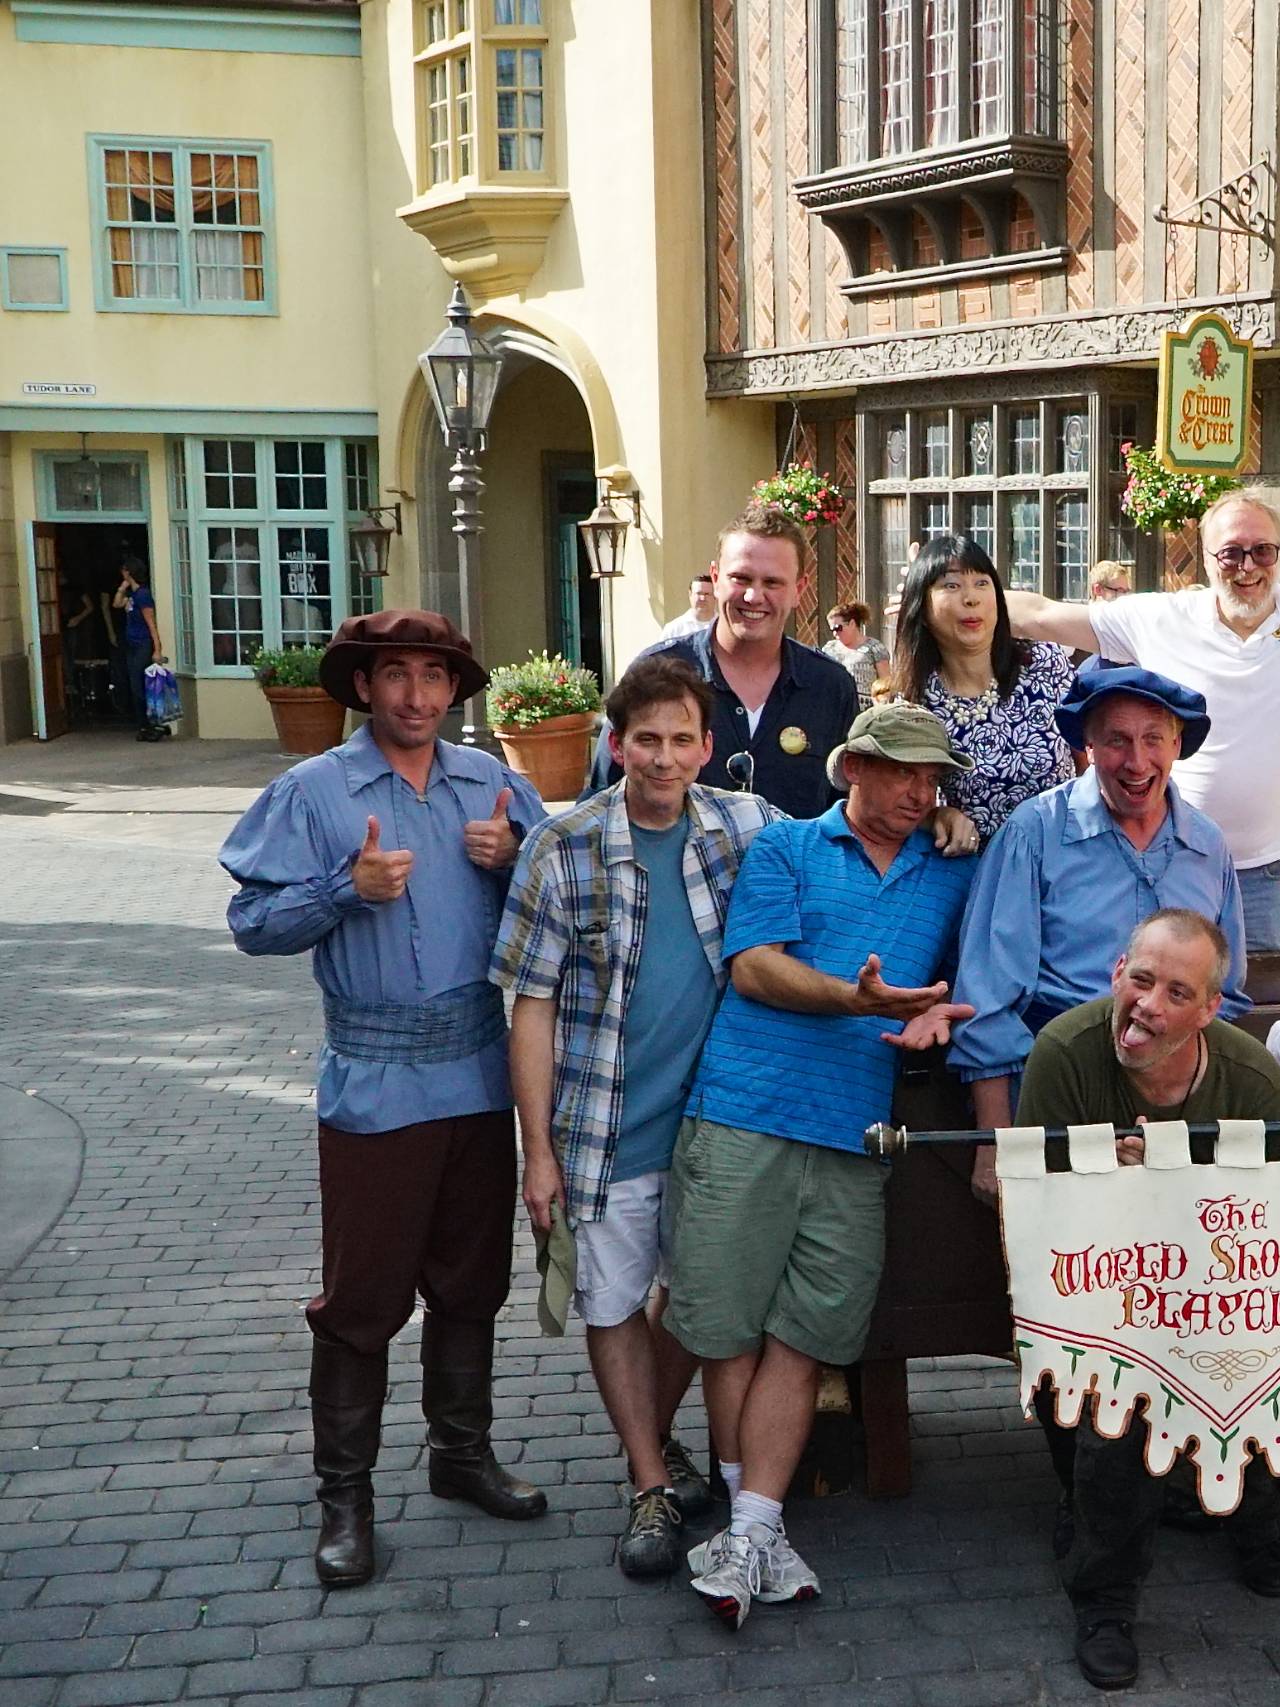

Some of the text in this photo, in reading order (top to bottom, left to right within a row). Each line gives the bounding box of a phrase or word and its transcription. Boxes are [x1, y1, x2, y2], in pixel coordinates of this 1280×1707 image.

[26, 384, 93, 393] TUDOR LANE
[1181, 388, 1232, 423] Crown
[1191, 416, 1234, 451] Crest
[1195, 1193, 1269, 1233] The
[1050, 1241, 1189, 1298] WORLD
